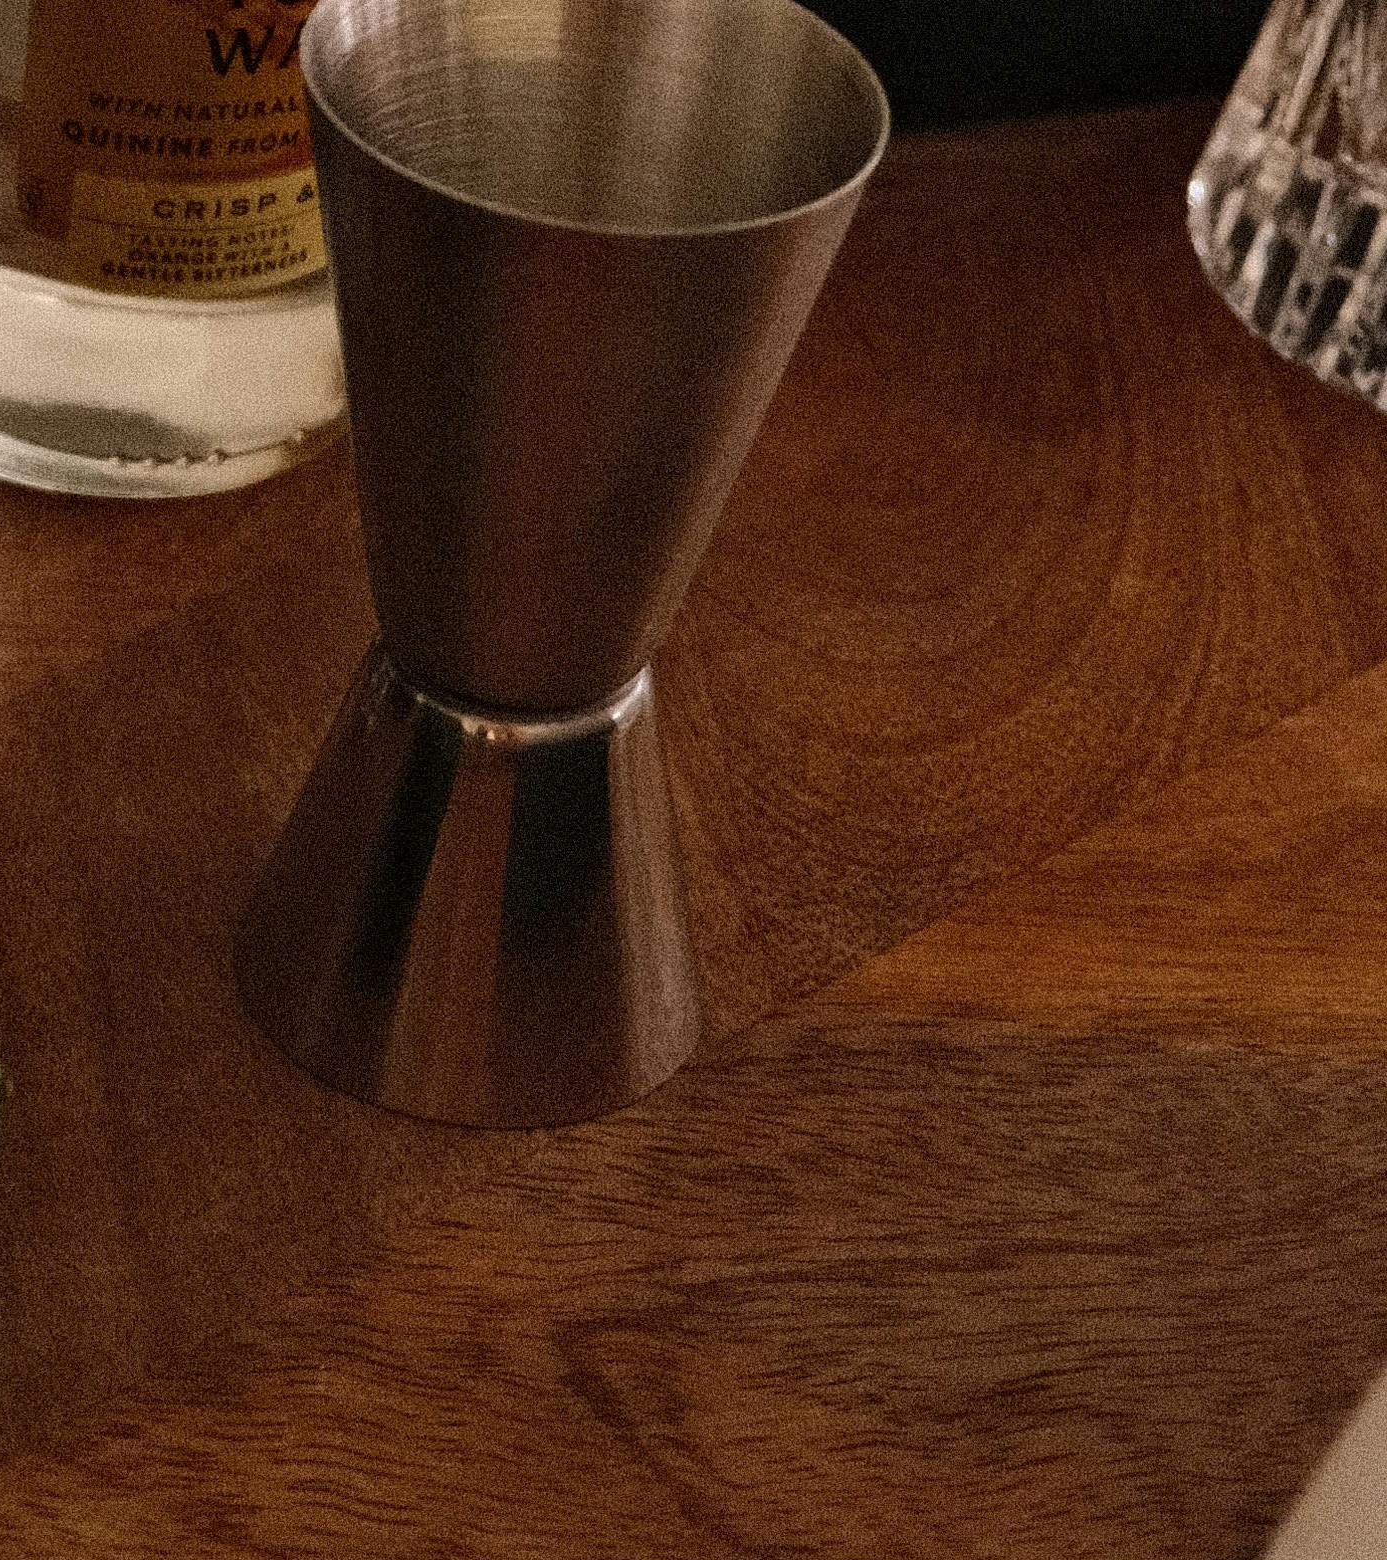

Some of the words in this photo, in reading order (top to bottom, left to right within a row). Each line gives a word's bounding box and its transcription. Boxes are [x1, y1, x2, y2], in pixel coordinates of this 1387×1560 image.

[88, 92, 165, 119] WITH
[174, 95, 299, 122] NATURAL
[62, 119, 213, 158] QUININE
[226, 131, 300, 156] FROM
[152, 192, 278, 220] CRISP
